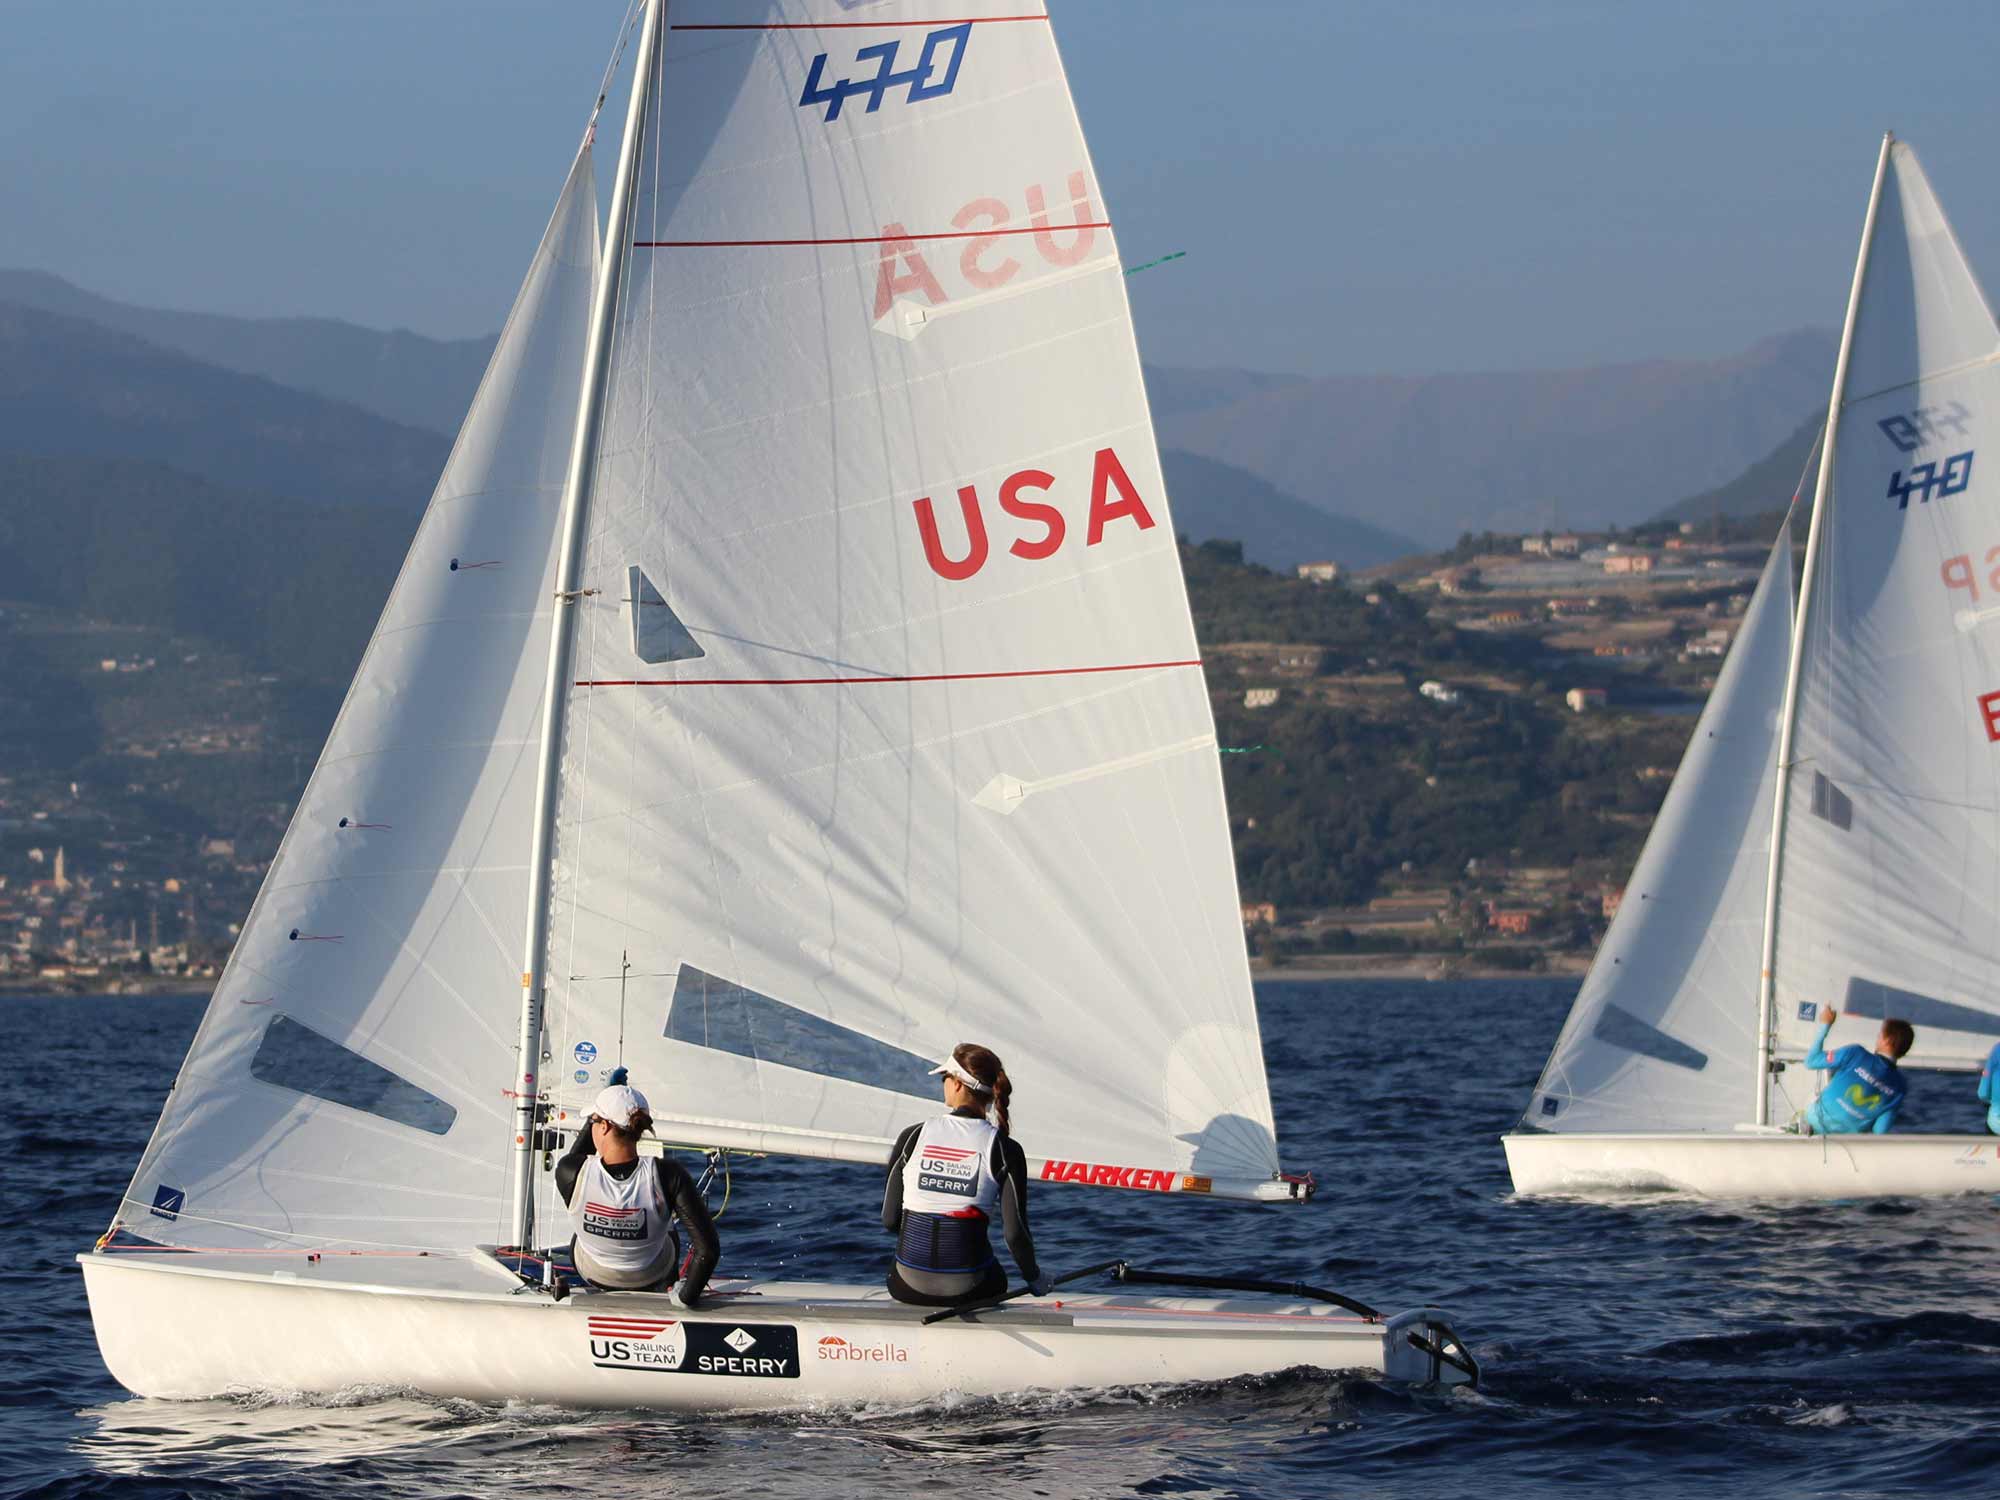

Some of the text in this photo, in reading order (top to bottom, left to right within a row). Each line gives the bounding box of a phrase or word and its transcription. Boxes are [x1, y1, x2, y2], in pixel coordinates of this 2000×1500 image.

[800, 22, 972, 122] 470
[1886, 450, 1974, 510] 470
[912, 447, 1156, 581] USA
[920, 1159, 945, 1173] US
[946, 1168, 971, 1177] TEAM
[920, 1176, 969, 1192] SPERRY
[1040, 1159, 1176, 1193] HARKEN
[583, 1213, 609, 1225] US
[585, 1224, 638, 1238] SPERRY
[590, 1339, 675, 1361] US SAILING
[633, 1352, 677, 1364] TEAM
[818, 1342, 907, 1362] sunbrella
[698, 1355, 788, 1374] SPERRY
